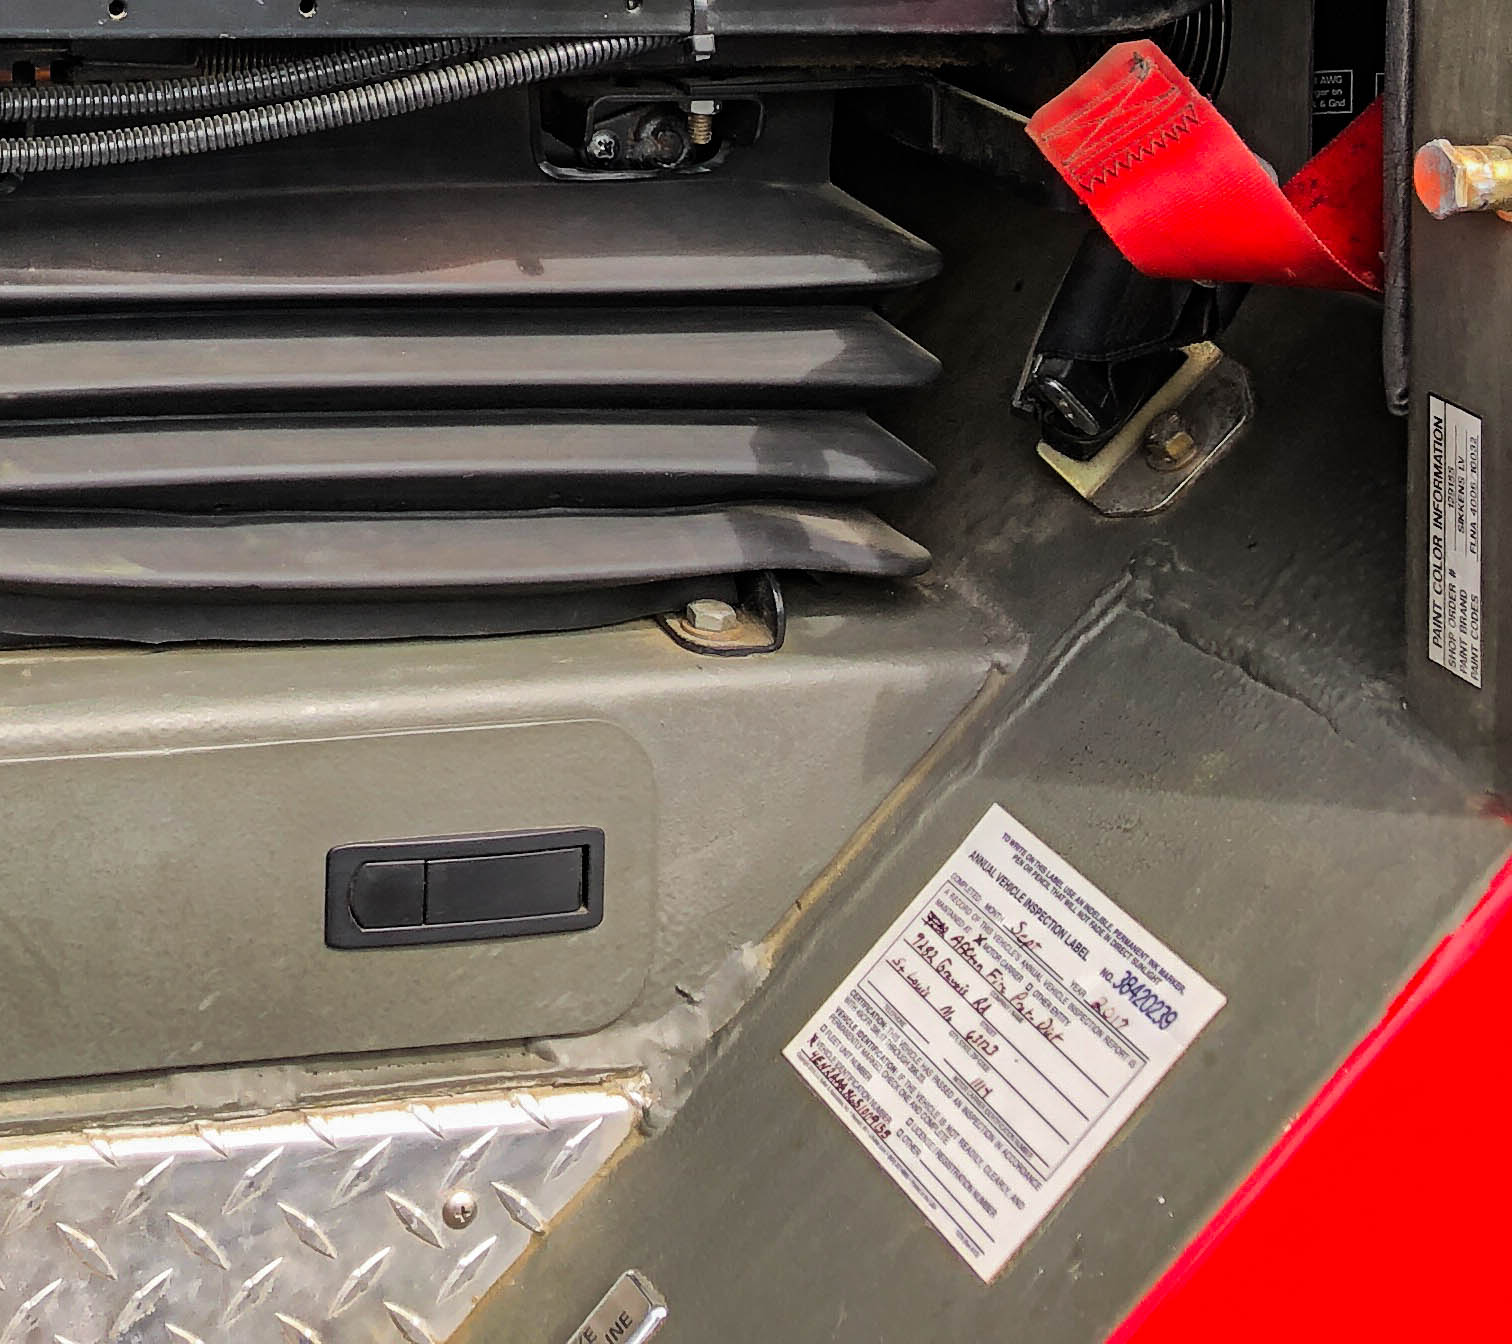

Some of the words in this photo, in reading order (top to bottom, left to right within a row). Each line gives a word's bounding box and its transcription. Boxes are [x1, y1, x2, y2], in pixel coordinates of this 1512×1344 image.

[1329, 99, 1345, 107] Gnd
[1432, 414, 1442, 530] INFORMATION
[1432, 533, 1442, 596] COLOR
[1432, 598, 1442, 649] PAINT
[1459, 637, 1467, 675] PAINT
[1011, 853, 1025, 867] PEN
[1022, 863, 1033, 874] OR
[1049, 886, 1065, 902] THAT
[1062, 898, 1079, 913] WILL
[967, 849, 998, 878] ANNUAL
[994, 872, 1026, 903] VEHICLE
[1022, 897, 1068, 940] INSPECTION
[1063, 934, 1091, 961] LABEL
[1113, 970, 1178, 1031] 38420239
[1066, 1001, 1105, 1038] INSPECTION
